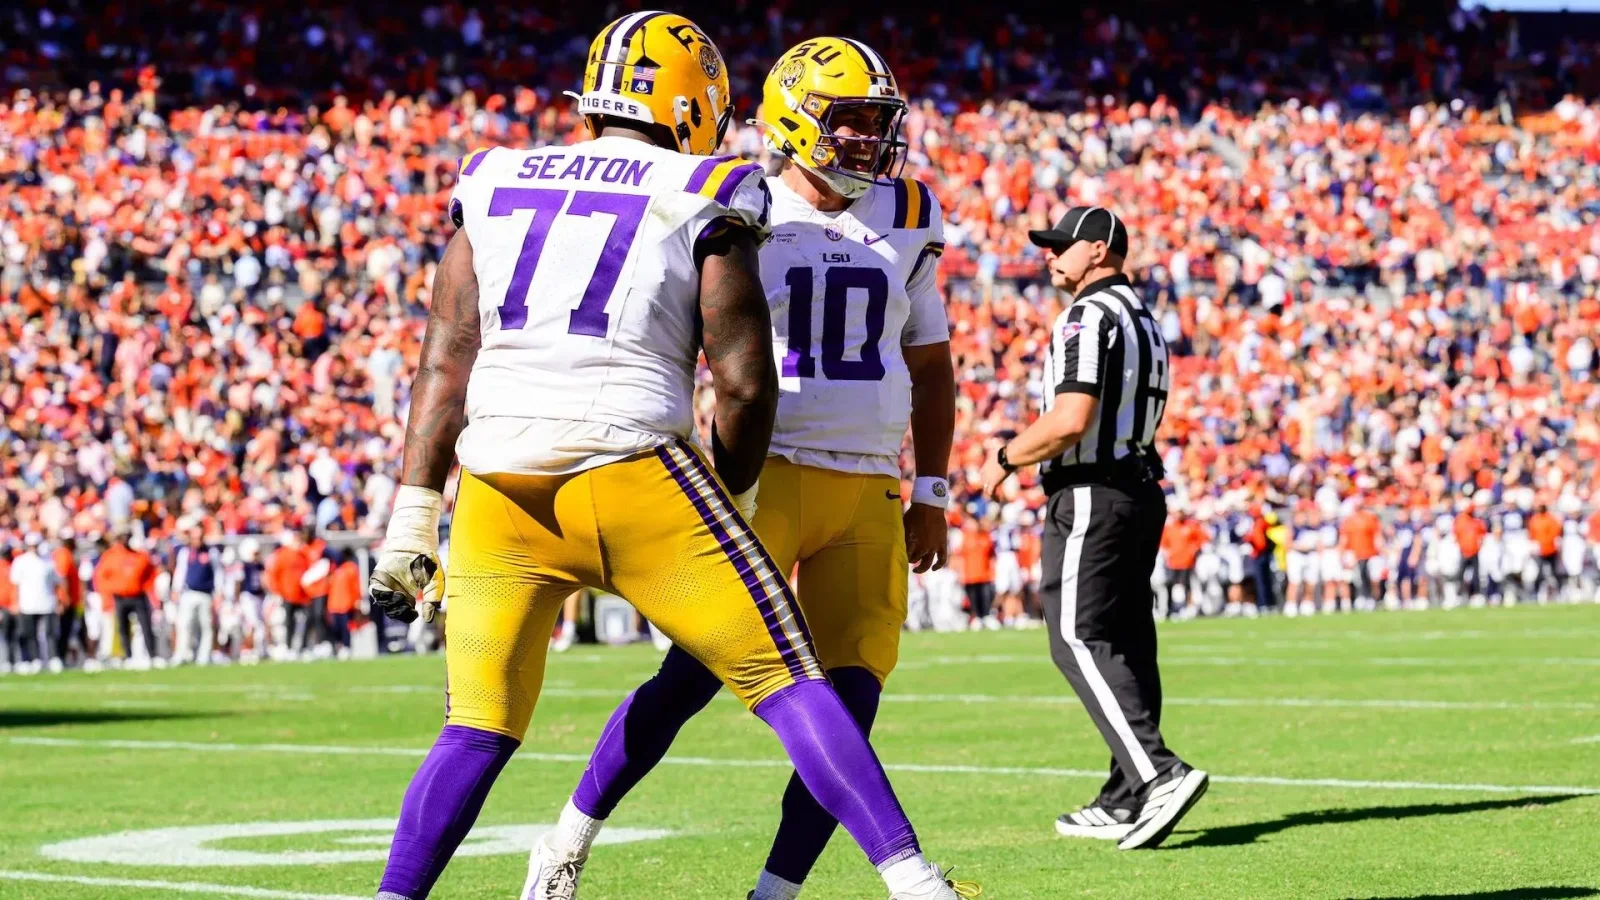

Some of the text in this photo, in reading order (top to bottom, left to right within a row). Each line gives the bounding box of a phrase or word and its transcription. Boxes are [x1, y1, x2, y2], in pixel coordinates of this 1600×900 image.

[581, 97, 638, 115] TIGERS
[517, 154, 653, 187] SEATON
[487, 186, 650, 338] 77
[822, 252, 851, 263] LSU
[782, 266, 888, 381] 10
